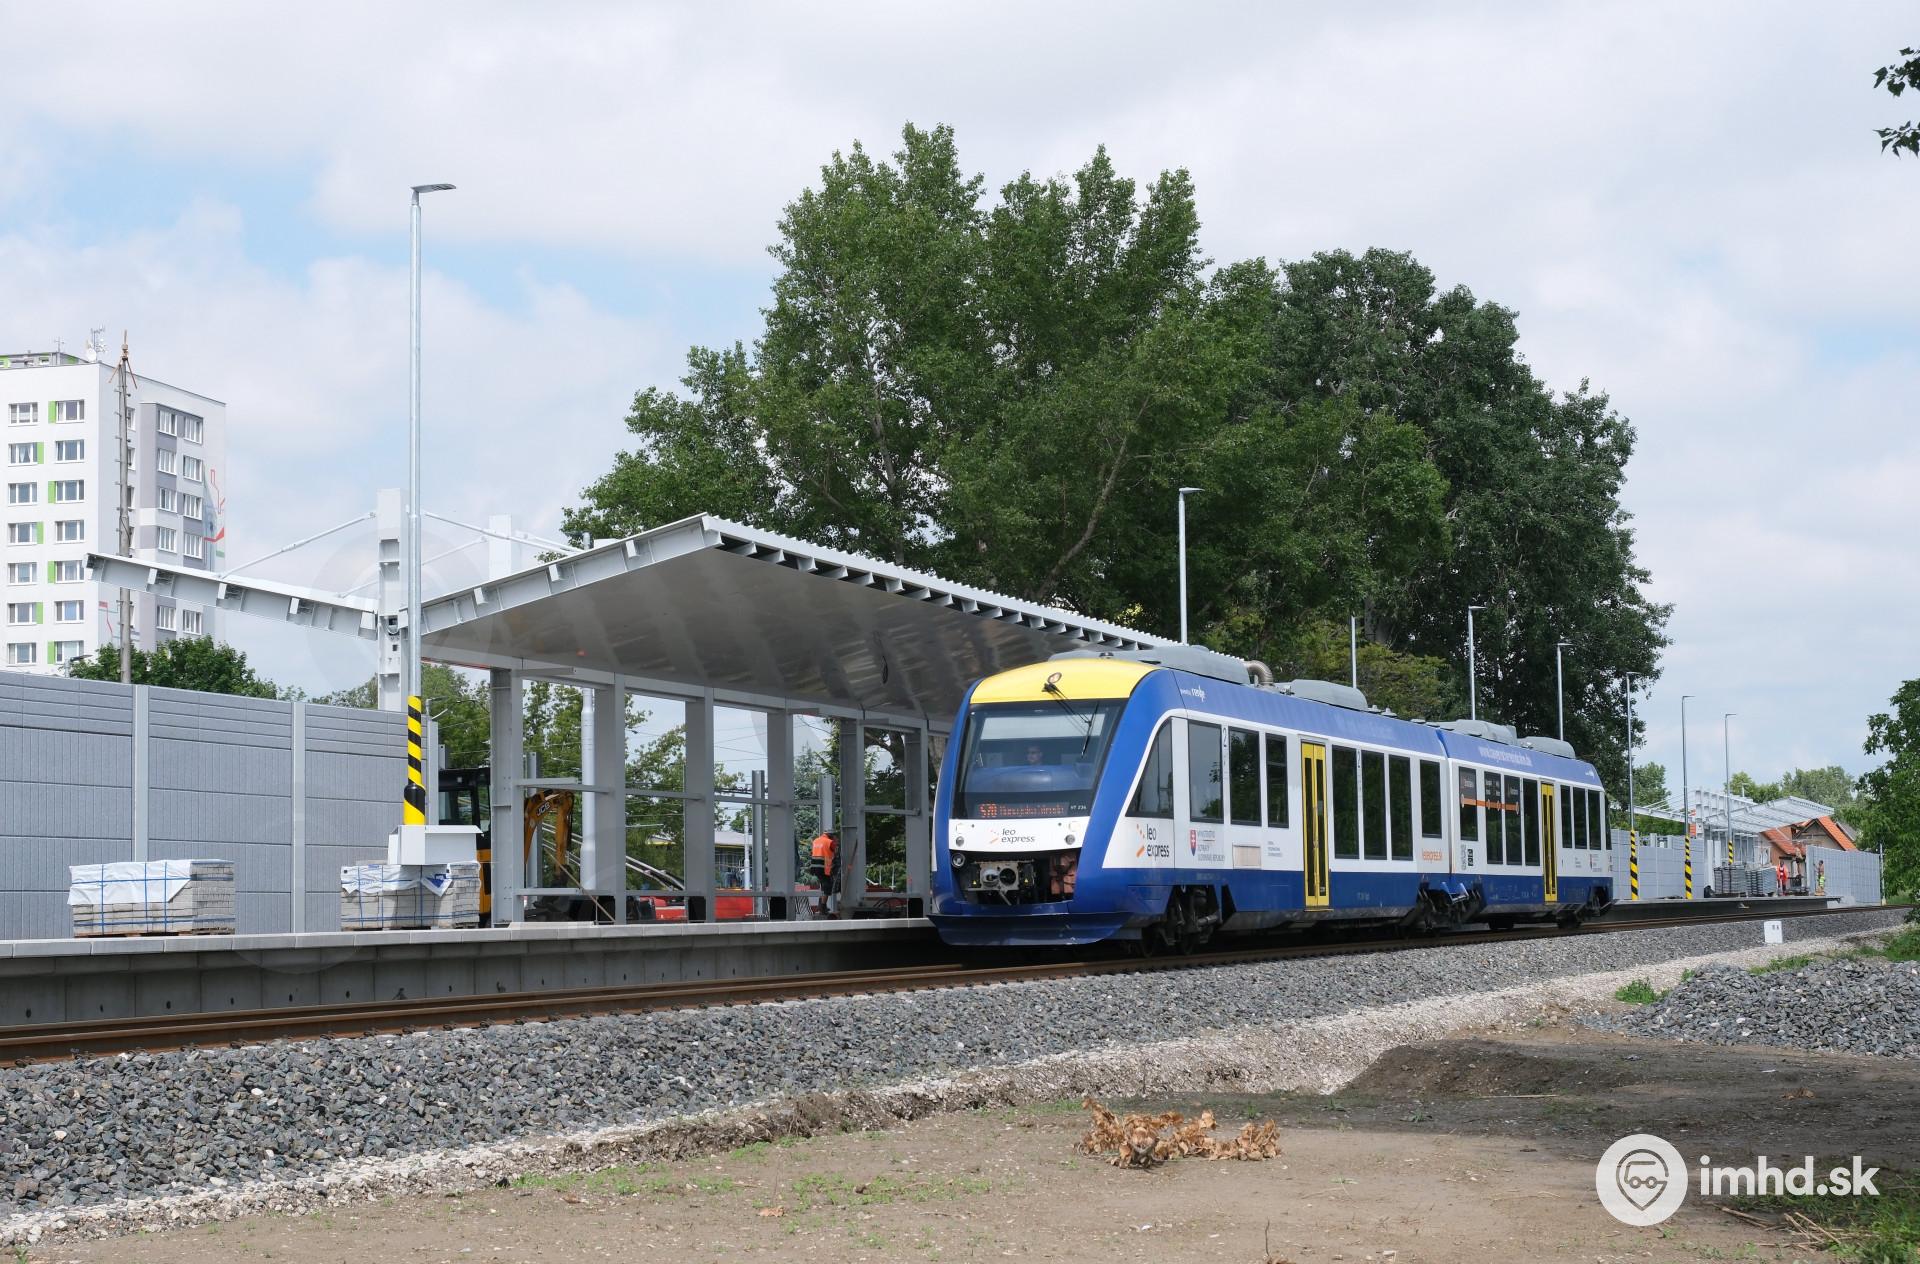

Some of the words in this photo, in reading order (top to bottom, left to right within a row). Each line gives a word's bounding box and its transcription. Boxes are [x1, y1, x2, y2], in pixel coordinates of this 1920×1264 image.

[536, 802, 550, 816] JCB
[1002, 828, 1016, 836] leo
[1146, 823, 1157, 840] leo
[1001, 836, 1036, 845] express
[1146, 844, 1170, 861] express
